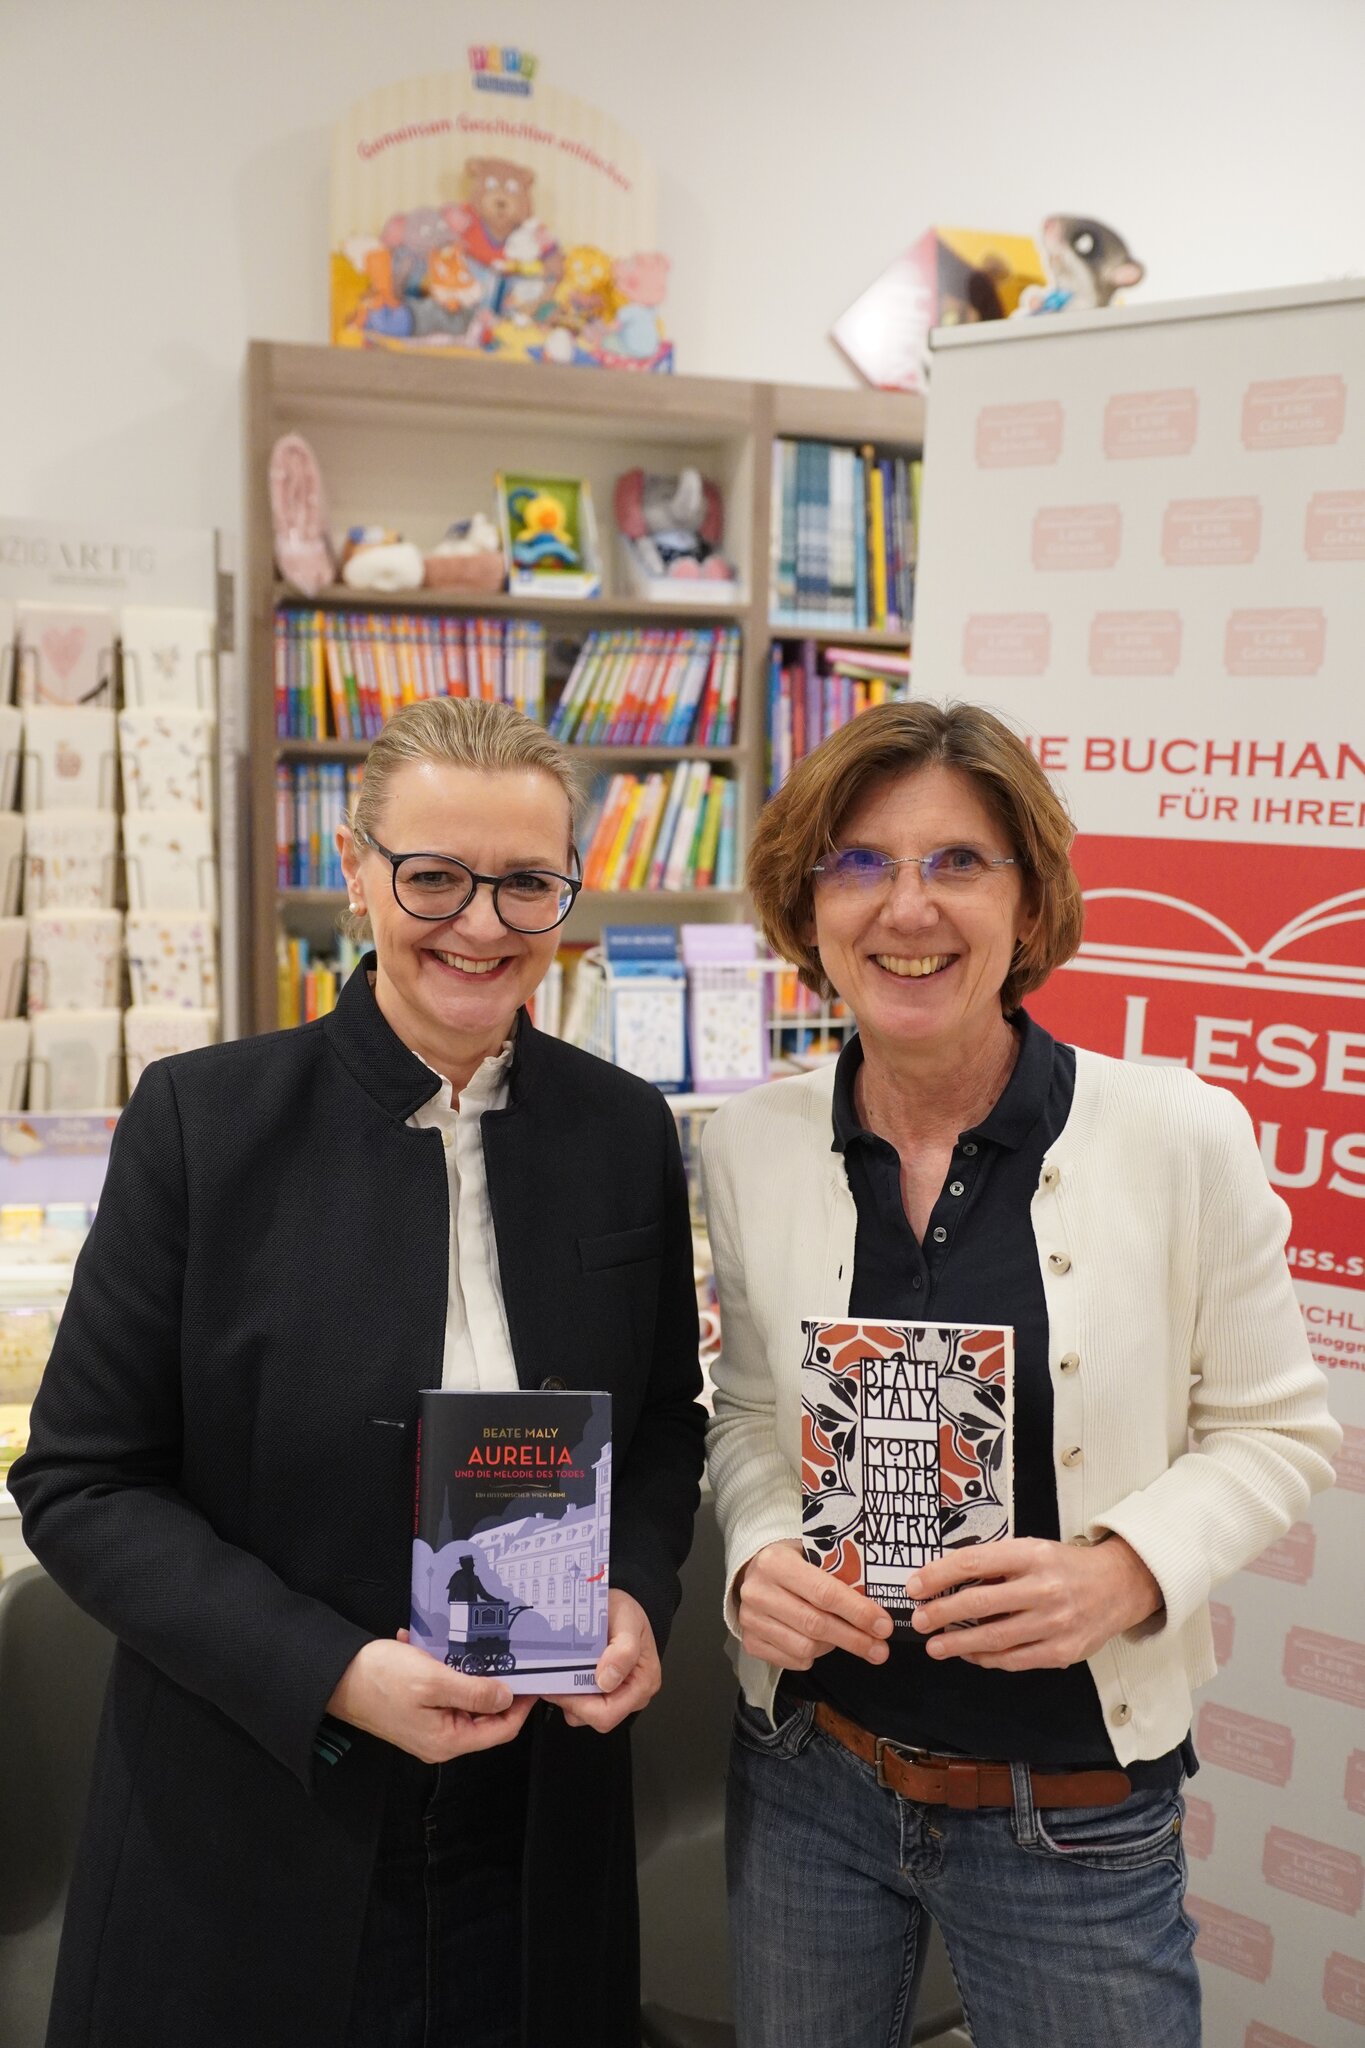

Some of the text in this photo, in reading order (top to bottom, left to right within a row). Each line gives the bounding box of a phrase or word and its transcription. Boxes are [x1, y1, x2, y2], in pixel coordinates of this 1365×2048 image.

[1084, 738, 1365, 780] BUCHHAN
[1159, 788, 1365, 828] FÜR IHRE
[1124, 996, 1365, 1096] LESE
[1300, 1304, 1365, 1332] CHL
[865, 1358, 938, 1389] BEATE
[865, 1387, 938, 1420] MALY
[483, 1428, 559, 1438] BEATE MALY
[467, 1446, 573, 1466] AURELIA
[866, 1438, 938, 1468] MORD
[455, 1471, 585, 1479] UND DIE MELODIE DES TODES
[865, 1491, 939, 1516] WIENER
[865, 1512, 941, 1545] WERK
[573, 1673, 597, 1686] DUMO
